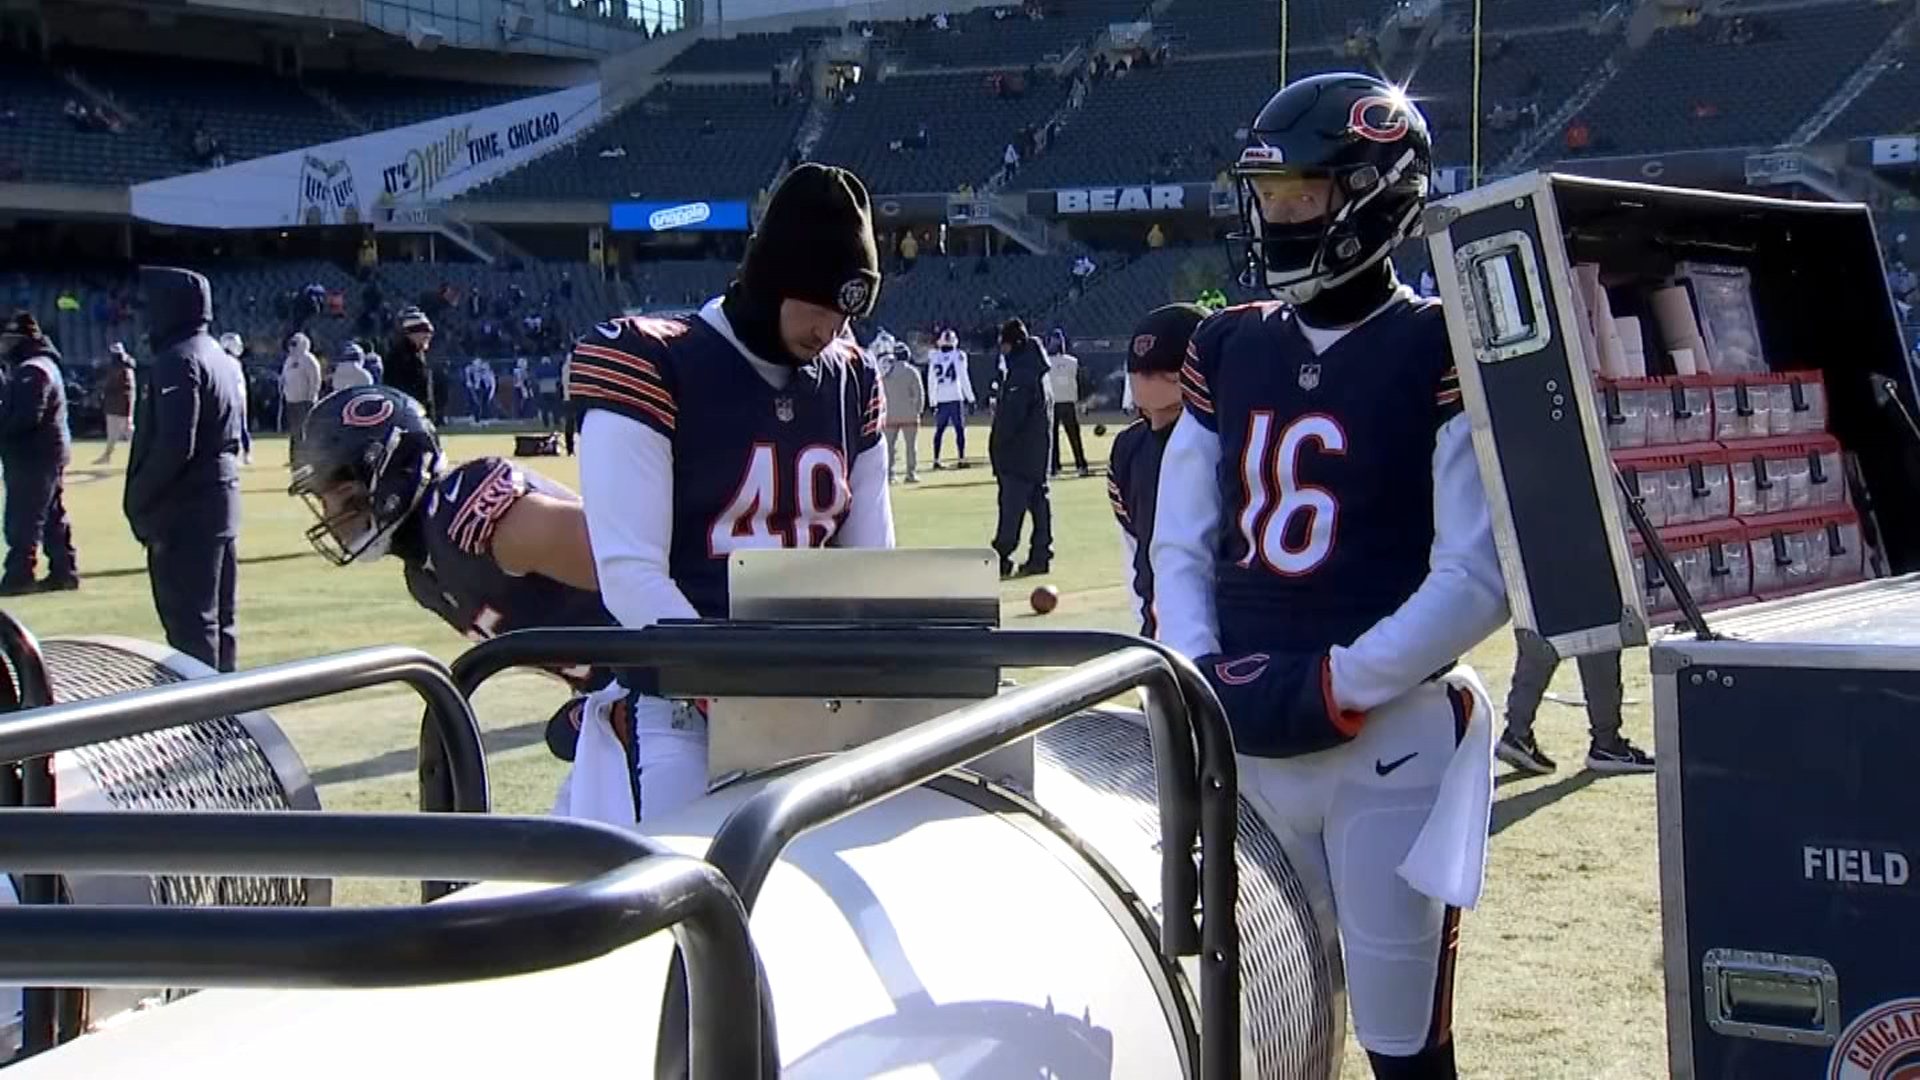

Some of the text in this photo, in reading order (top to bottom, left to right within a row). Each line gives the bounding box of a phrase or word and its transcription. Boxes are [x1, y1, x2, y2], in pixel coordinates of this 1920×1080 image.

[383, 163, 411, 194] IT'S
[467, 132, 504, 165] TIME,
[507, 112, 560, 149] CHICAGO
[1057, 187, 1184, 213] BEAR
[933, 361, 956, 384] 24
[707, 442, 851, 559] 48
[1237, 409, 1348, 577] 16
[1803, 847, 1909, 886] FIELD
